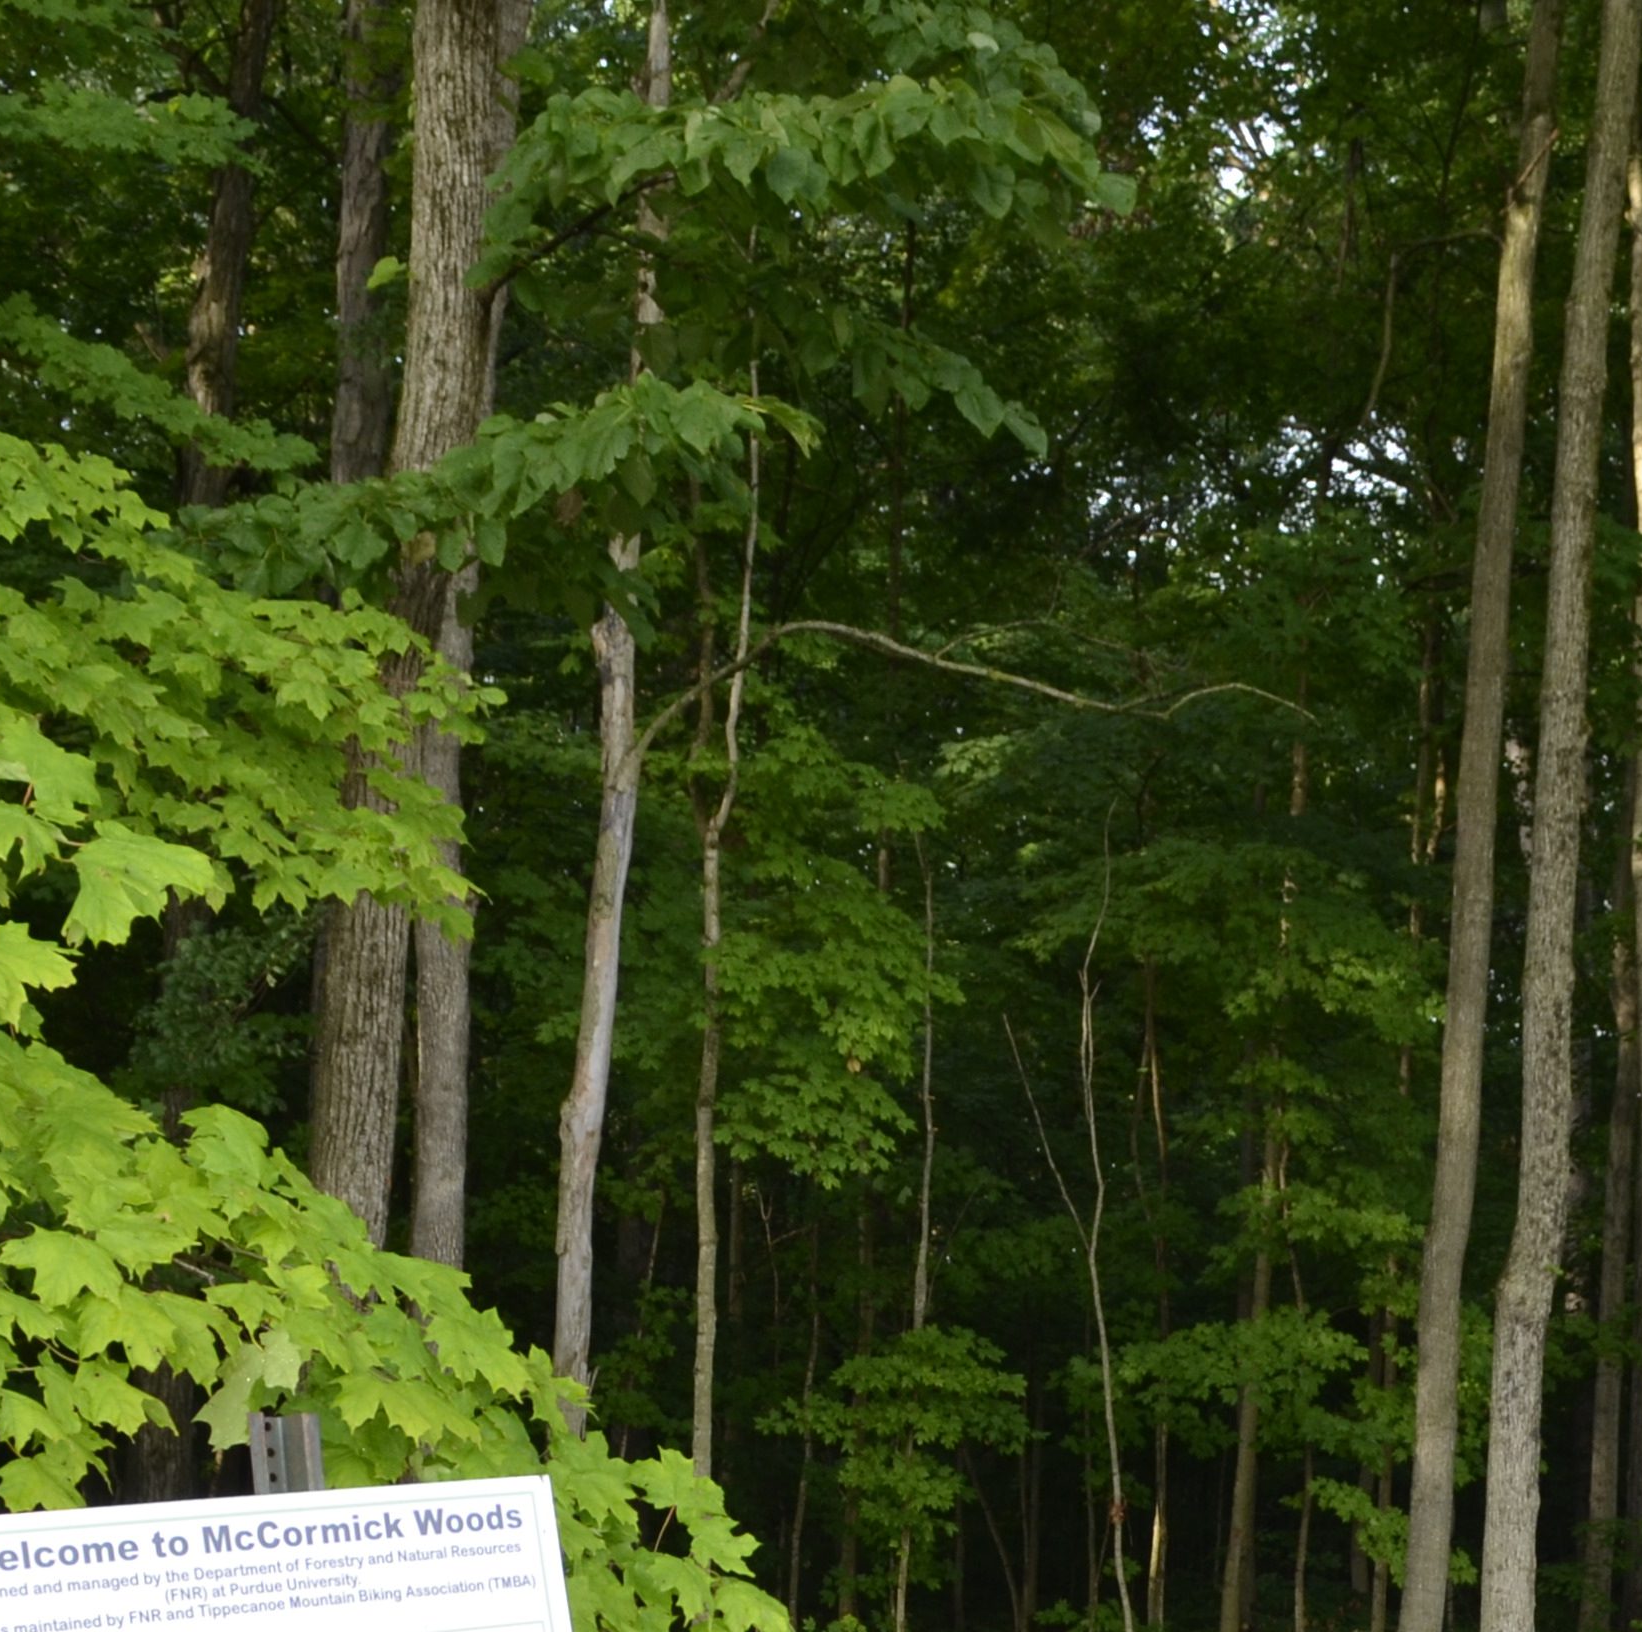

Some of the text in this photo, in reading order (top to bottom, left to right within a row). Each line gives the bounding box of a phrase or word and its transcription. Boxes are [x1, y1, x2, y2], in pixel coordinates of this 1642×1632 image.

[151, 1531, 189, 1558] to
[202, 1512, 404, 1554] McCormick
[413, 1504, 523, 1536] Woods
[33, 1579, 63, 1595] and
[67, 1572, 139, 1592] managed
[143, 1572, 161, 1588] by
[165, 1570, 189, 1583] the
[193, 1560, 283, 1582] Department
[285, 1558, 299, 1573] of
[304, 1555, 364, 1570] Forestry
[368, 1551, 394, 1565] and
[397, 1546, 448, 1562] Natural
[450, 1543, 522, 1558] Resources
[165, 1573, 361, 1605] (FNR) at Purdue University.
[105, 1614, 124, 1629] by
[128, 1608, 162, 1624] FNR
[166, 1606, 195, 1621] and
[197, 1600, 285, 1619] Tippecanoe
[289, 1592, 355, 1609] Mountain
[358, 1588, 402, 1602] Biking
[406, 1581, 485, 1598] Association
[488, 1575, 536, 1592] (TMBA)
